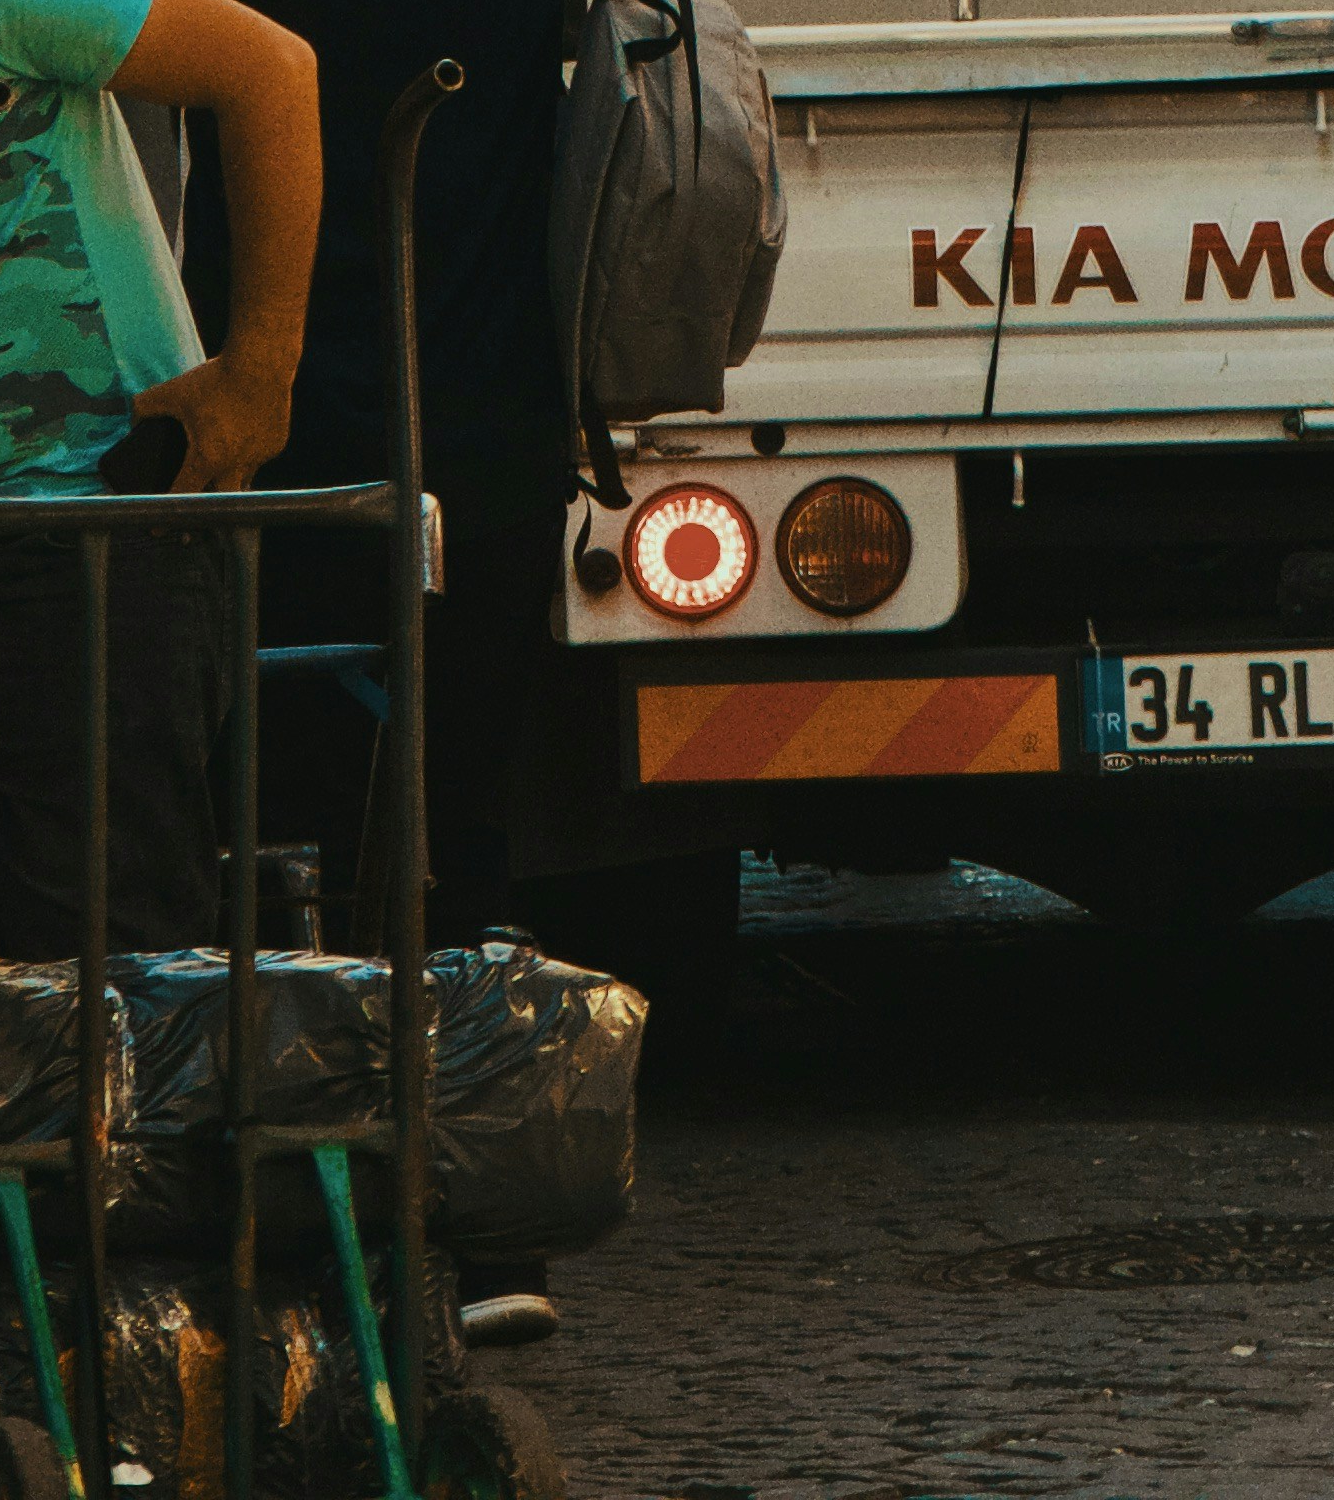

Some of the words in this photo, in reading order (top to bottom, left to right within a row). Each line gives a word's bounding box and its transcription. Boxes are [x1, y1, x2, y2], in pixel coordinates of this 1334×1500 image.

[911, 223, 1140, 308] KIA
[1128, 663, 1214, 744] 34
[1248, 659, 1334, 739] RL
